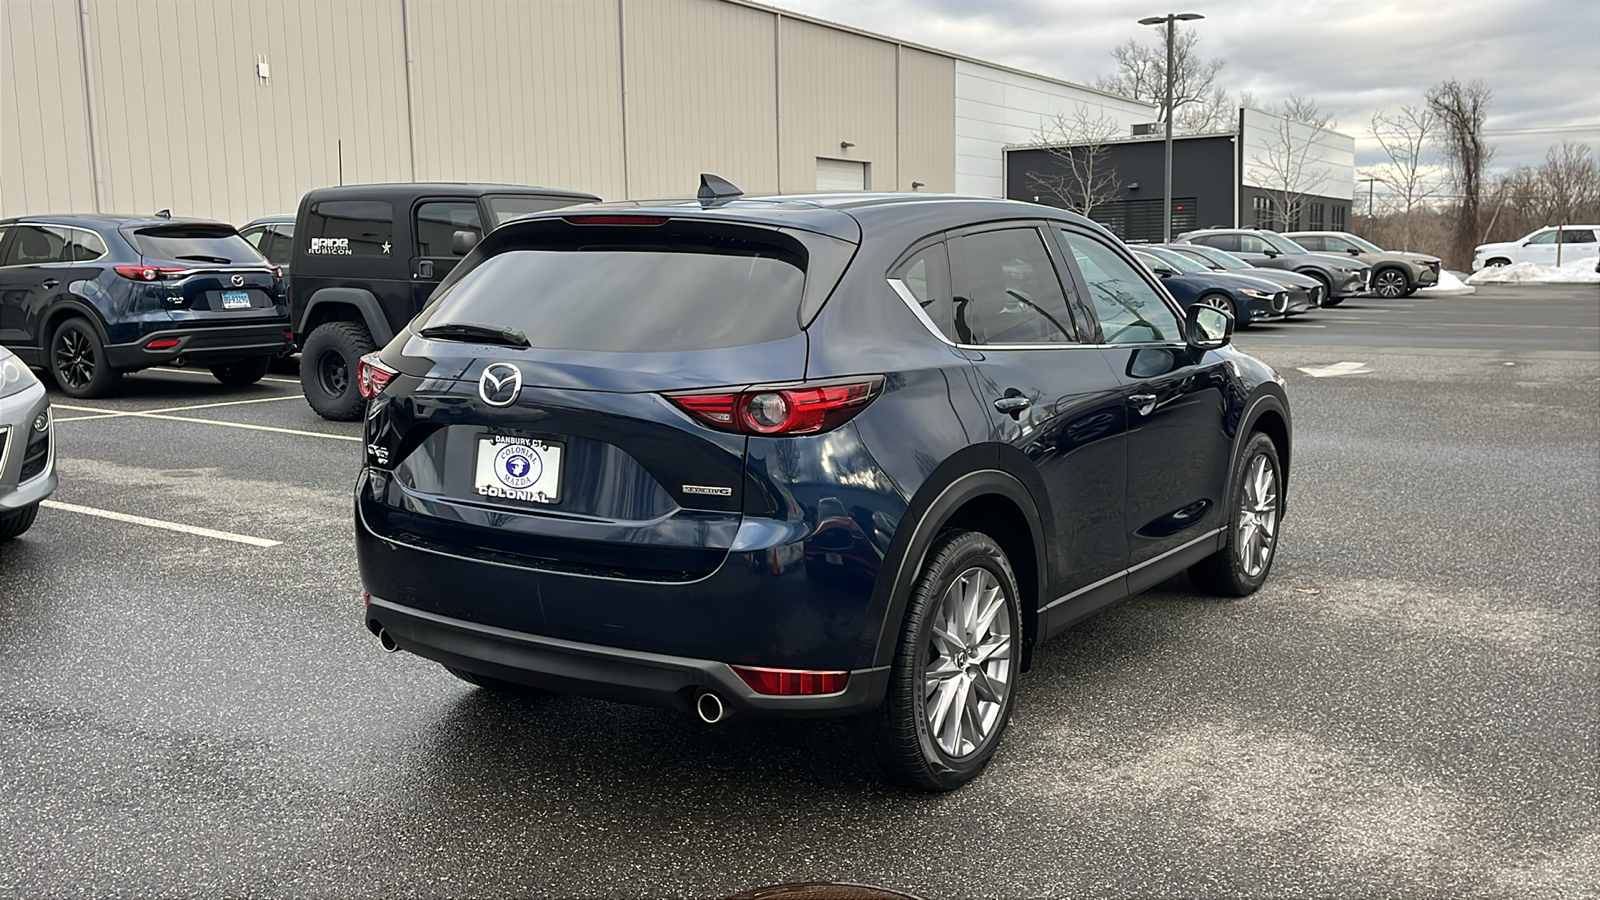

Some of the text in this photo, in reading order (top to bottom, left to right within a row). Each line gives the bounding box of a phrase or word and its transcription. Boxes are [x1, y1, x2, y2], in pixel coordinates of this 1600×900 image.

[532, 439, 543, 447] CT
[501, 446, 537, 464] COLONIAL
[503, 474, 532, 486] MAZDA
[478, 486, 549, 503] COLONIAL
